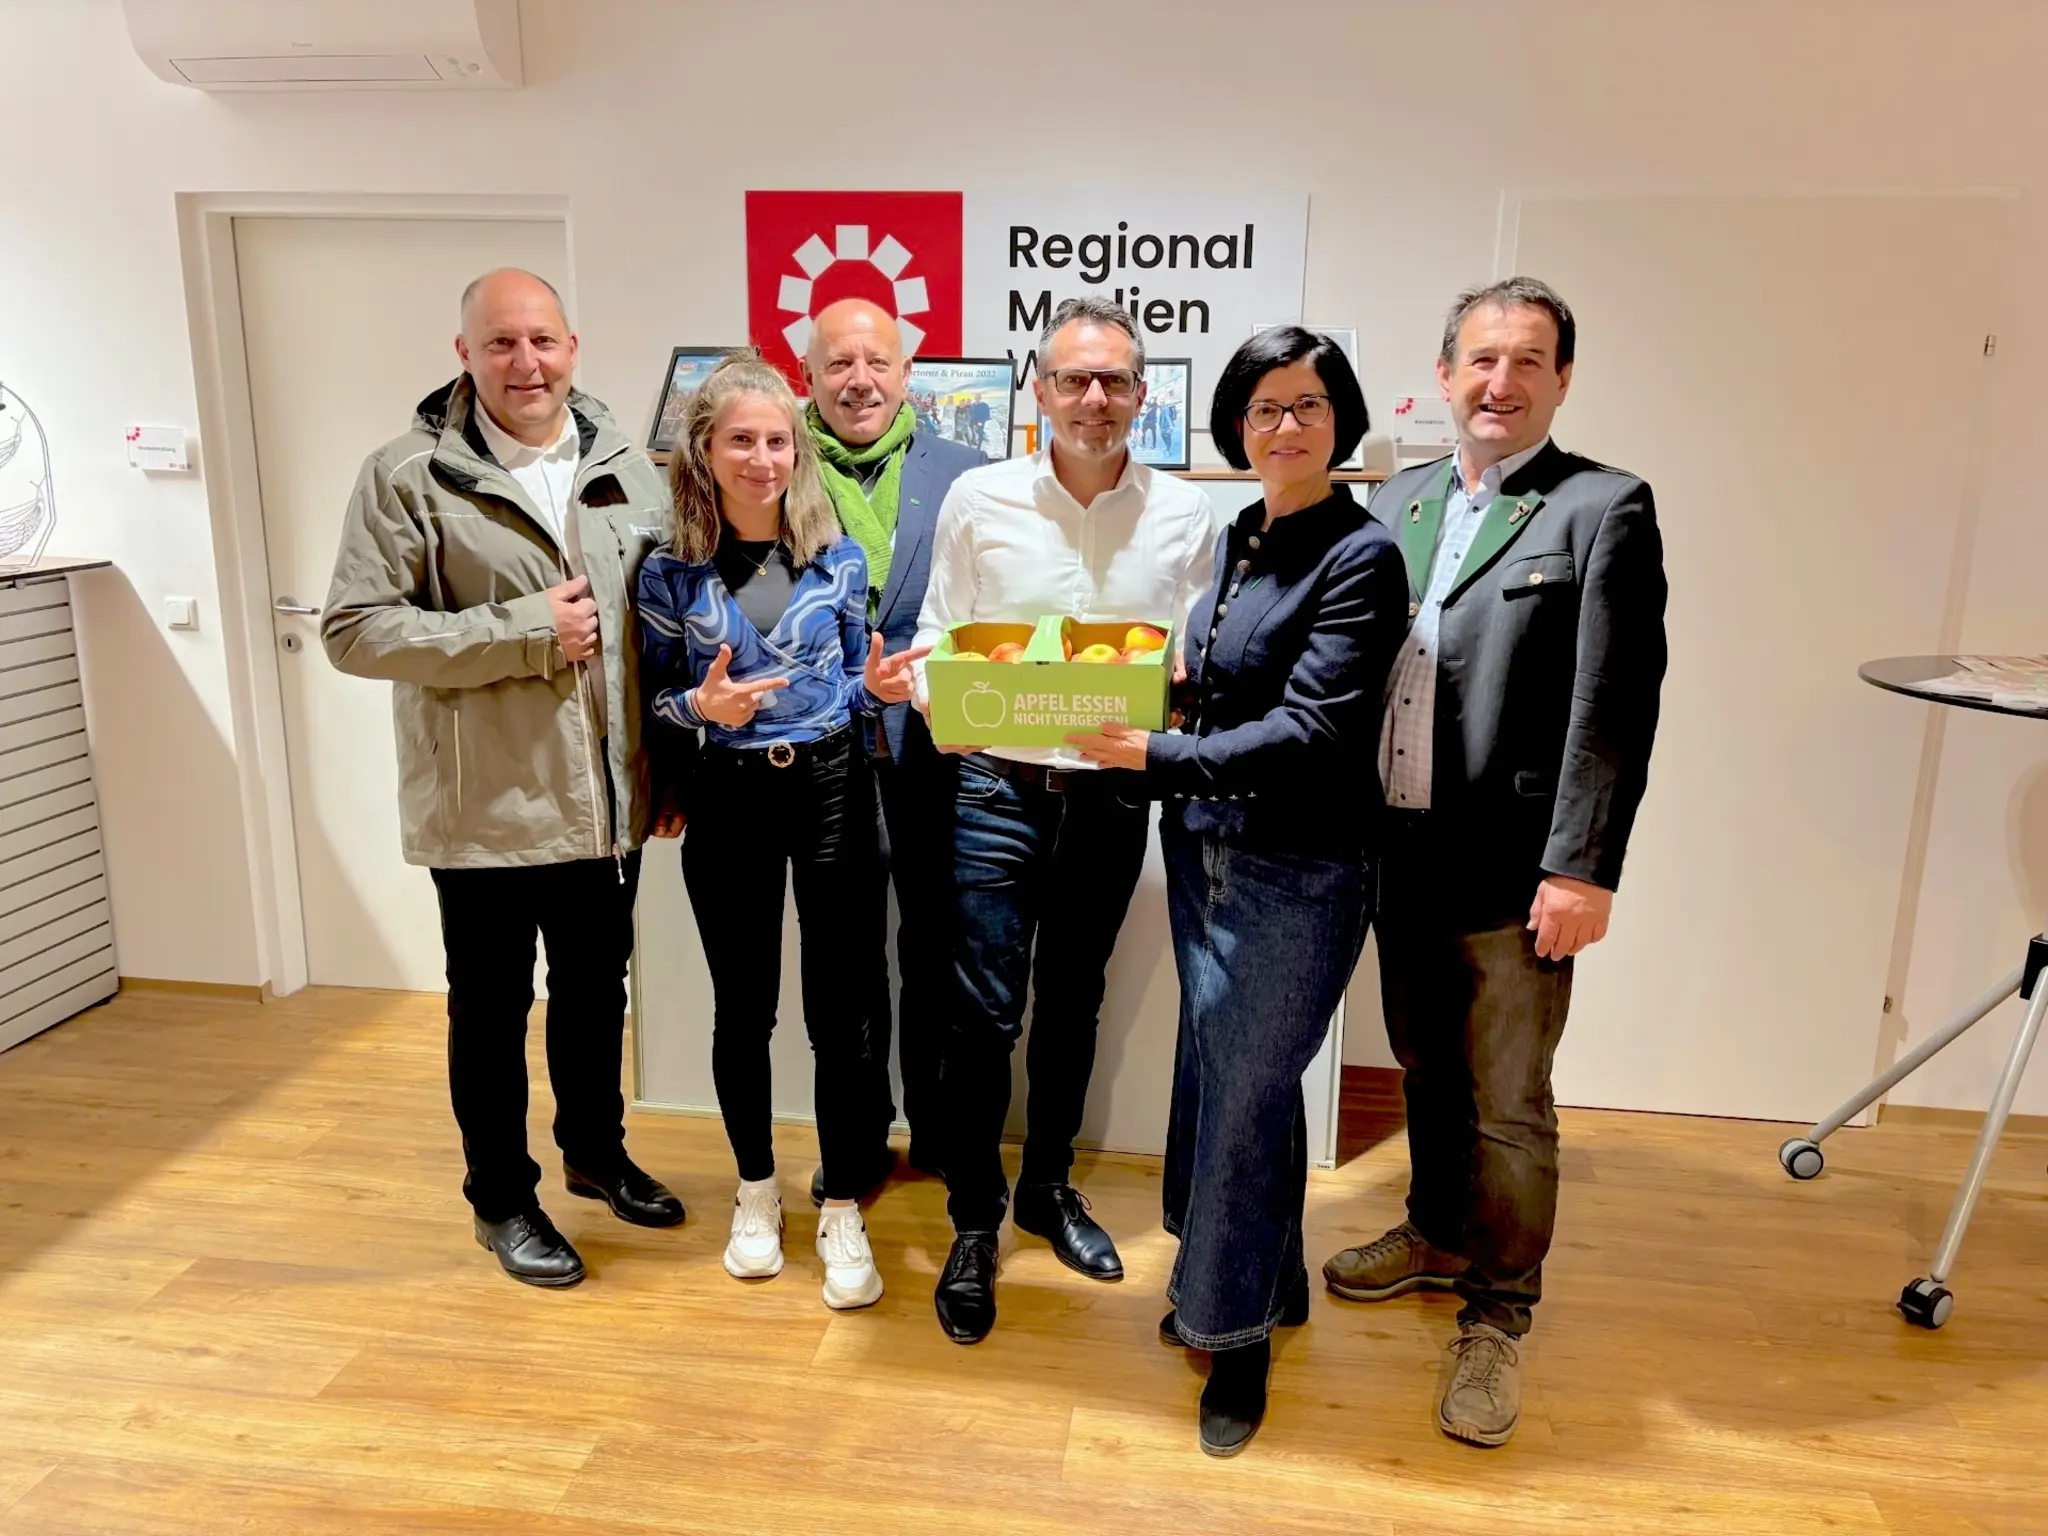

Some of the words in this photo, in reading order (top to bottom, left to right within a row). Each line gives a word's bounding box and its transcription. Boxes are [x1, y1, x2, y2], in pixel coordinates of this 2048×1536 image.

[1009, 221, 1254, 284] Regional
[1008, 286, 1210, 333] Mien
[976, 370, 997, 378] 2022
[1014, 693, 1068, 711] APFEL
[1072, 694, 1127, 713] ESSEN
[1013, 712, 1051, 725] NICHT
